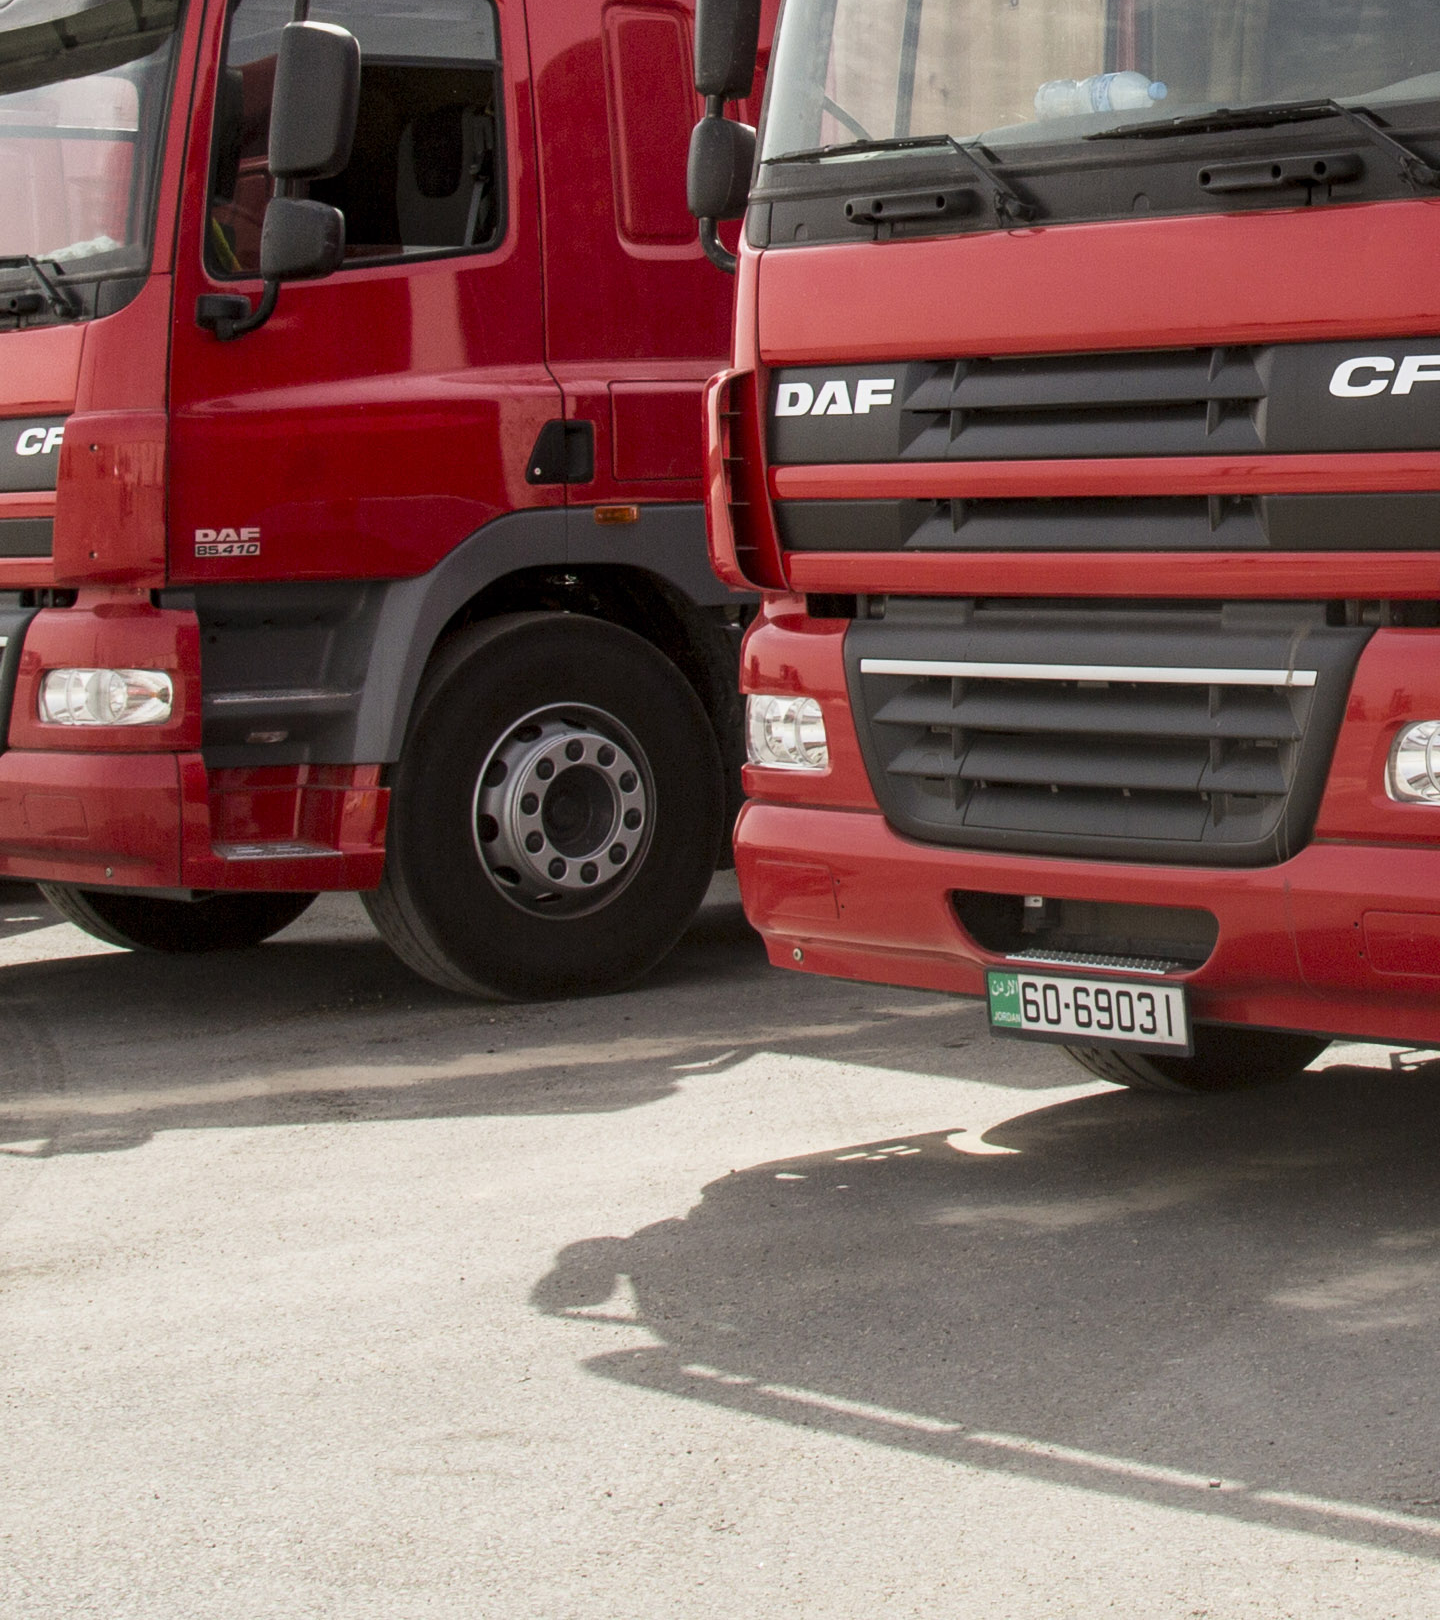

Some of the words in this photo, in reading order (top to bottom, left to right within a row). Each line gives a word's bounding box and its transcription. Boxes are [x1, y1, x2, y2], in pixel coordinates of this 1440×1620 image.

[775, 378, 895, 417] DAF
[15, 426, 65, 455] CF
[195, 527, 260, 542] DAF
[197, 544, 259, 555] 85.410
